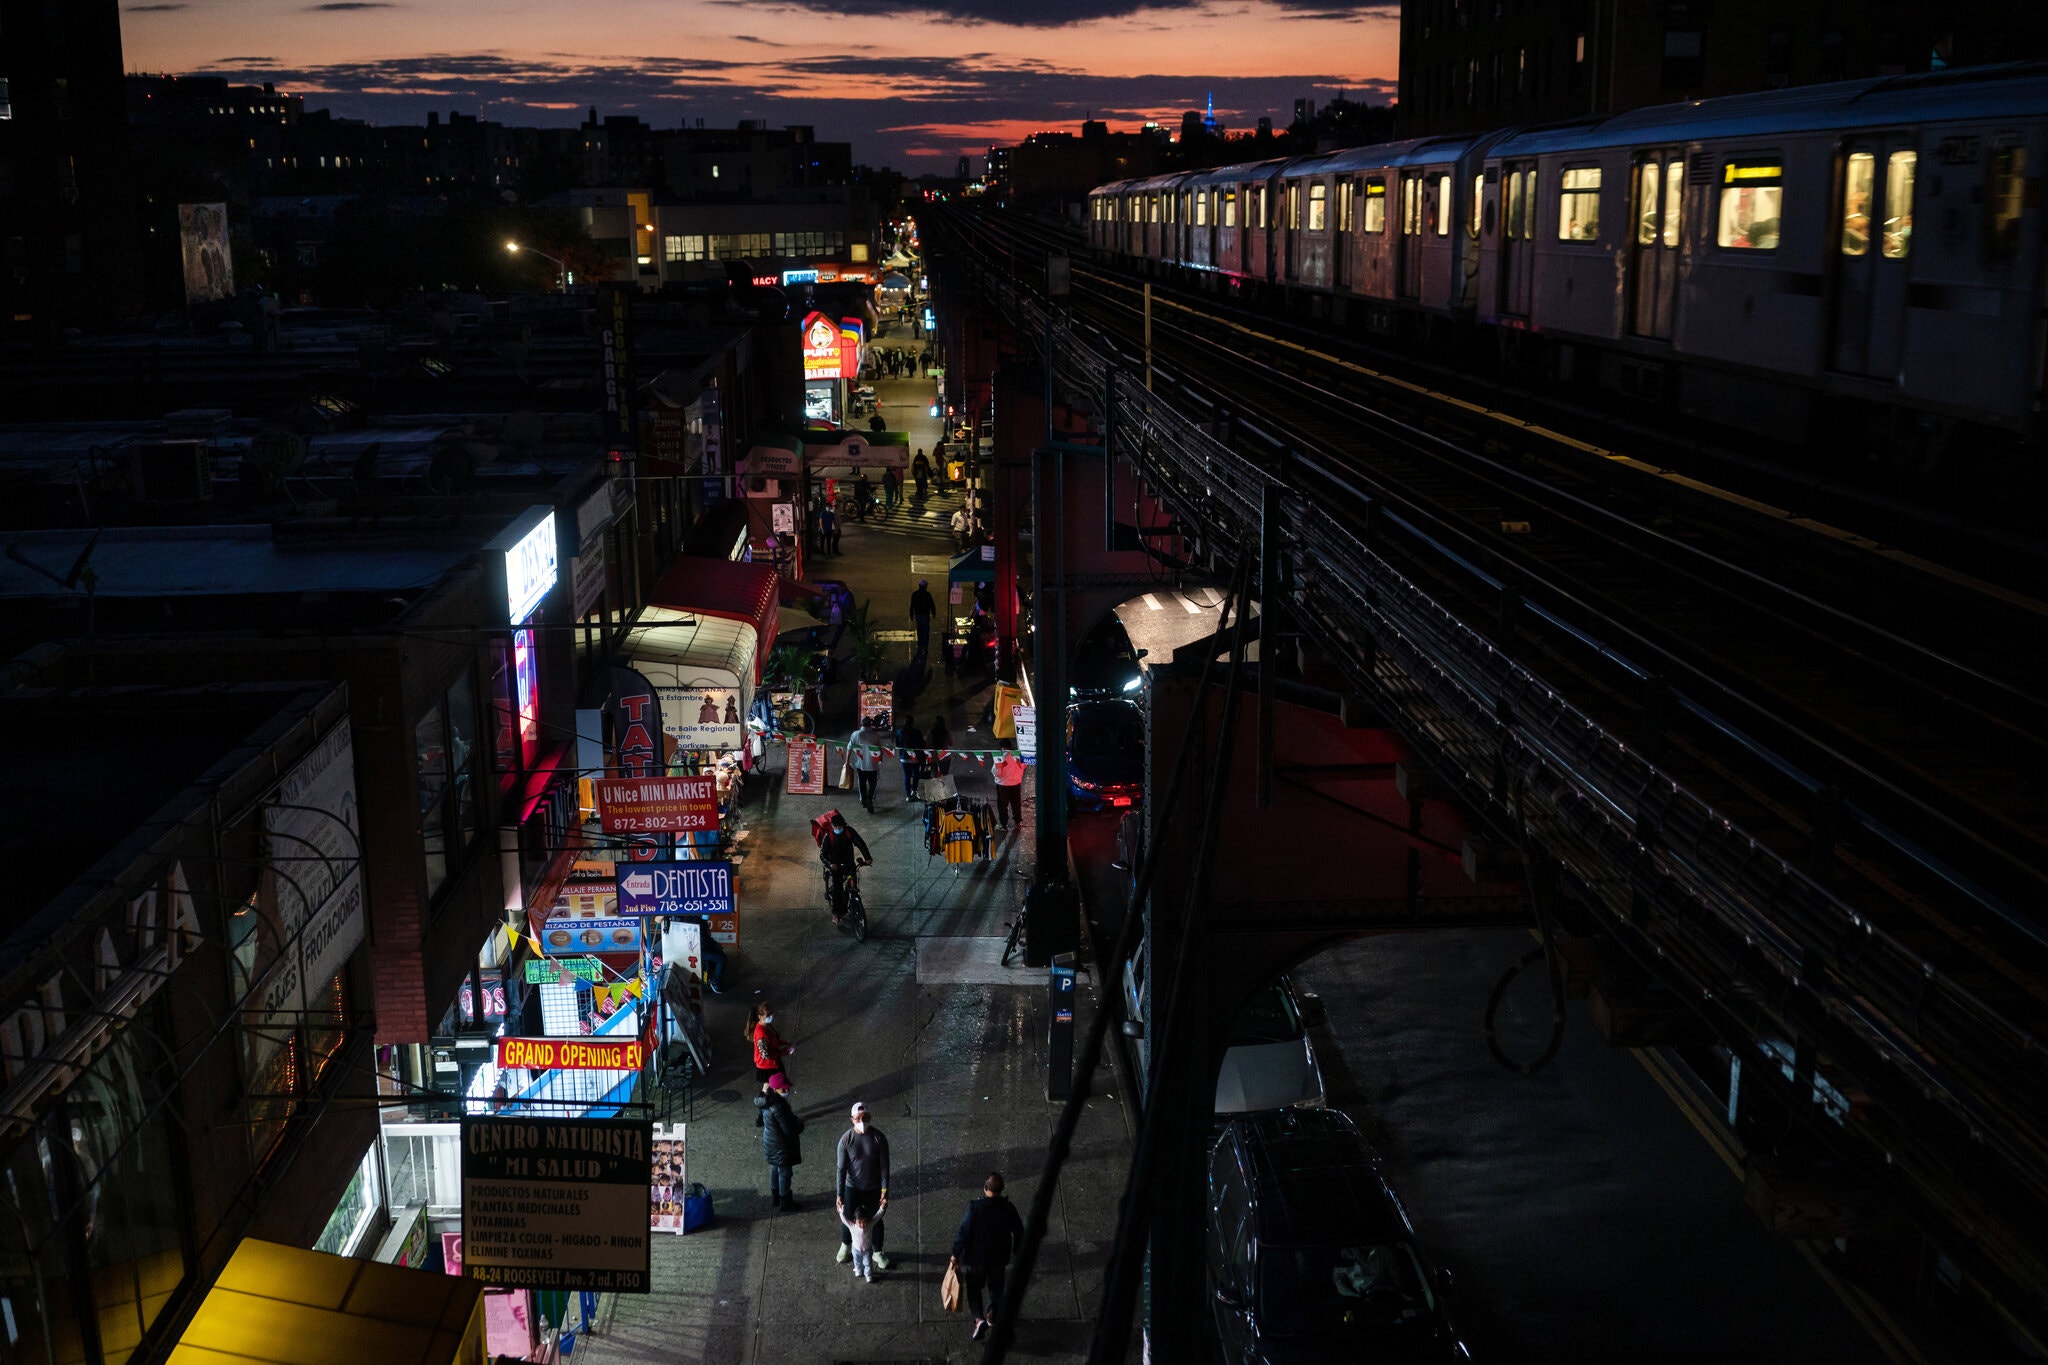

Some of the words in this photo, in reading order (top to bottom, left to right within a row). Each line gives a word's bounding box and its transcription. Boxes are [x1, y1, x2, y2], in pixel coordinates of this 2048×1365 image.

[613, 289, 628, 379] INCOME
[602, 329, 618, 412] CARGA
[804, 368, 840, 380] BAKERY
[619, 387, 630, 432] TAX
[604, 786, 611, 804] U
[614, 786, 638, 802] Nice
[640, 784, 665, 801] MINI
[667, 782, 712, 800] MARKET
[607, 805, 623, 814] The
[625, 804, 654, 814] lowest
[656, 803, 677, 815] price
[680, 803, 688, 811] in
[690, 803, 712, 812] town
[614, 815, 706, 830] 872-802-1234
[626, 880, 650, 889] Entrada
[654, 868, 728, 899] DENTISTA
[625, 904, 639, 912] 2nd
[640, 904, 656, 912] Piso
[304, 884, 360, 972] FROTACIONES
[545, 922, 578, 930] RIZADO
[594, 920, 636, 928] PESTAÑAS
[1062, 978, 1072, 990] P
[505, 1041, 554, 1066] GRAND
[560, 1044, 621, 1068] OPENING
[469, 1124, 539, 1155] CENTRO
[546, 1126, 644, 1162] NATURISTA
[506, 1157, 529, 1176] MI
[536, 1158, 602, 1178] SALUD
[472, 1186, 530, 1198] PRODUCTOS
[534, 1186, 590, 1200] NATURALES
[470, 1201, 514, 1214] PLANTAS
[517, 1202, 581, 1216] MEDICINALES
[471, 1216, 526, 1228] VITAMINAS
[470, 1231, 516, 1244] LIMPIEZA
[519, 1232, 552, 1245] COLON
[562, 1234, 601, 1246] HIGADO
[610, 1236, 642, 1248] RINON
[470, 1246, 508, 1258] ELIMINE
[512, 1247, 553, 1260] TOXINAS
[472, 1266, 500, 1281] 88-24
[504, 1268, 560, 1285] ROOSEVELT
[564, 1272, 586, 1286] Ave.
[589, 1272, 596, 1286] 2
[616, 1272, 640, 1288] PISO
